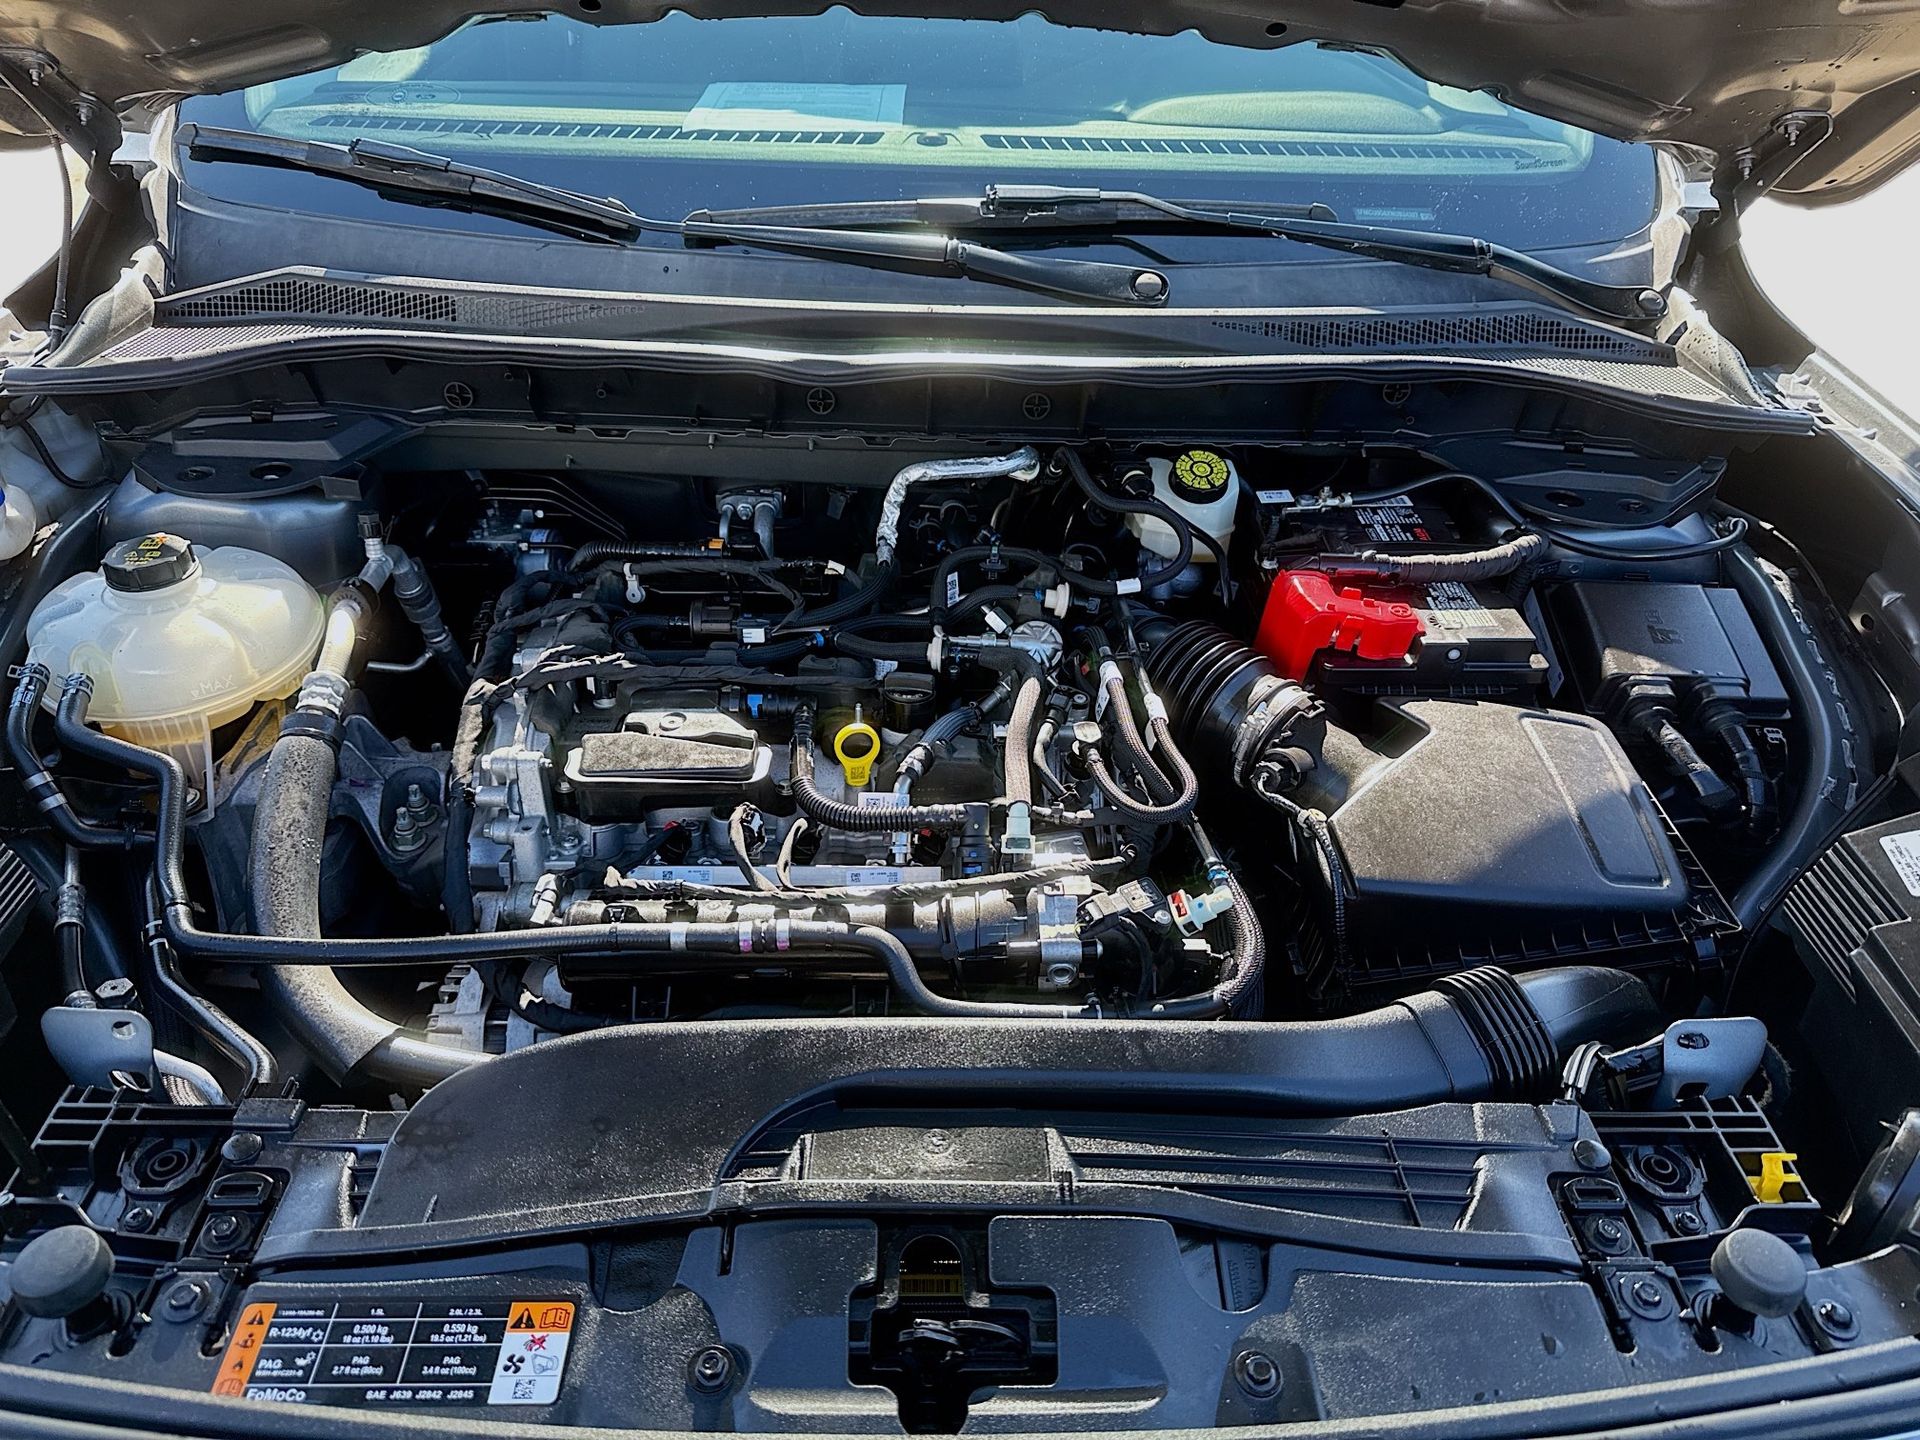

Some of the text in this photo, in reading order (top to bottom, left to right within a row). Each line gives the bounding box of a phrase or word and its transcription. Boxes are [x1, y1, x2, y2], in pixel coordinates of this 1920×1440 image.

[199, 675, 234, 694] MAX
[268, 1327, 313, 1339] R-1234yf
[353, 1324, 389, 1336] 0.500 kg
[443, 1323, 479, 1335] 0.550 kg
[430, 1334, 446, 1342] 19.5
[258, 1359, 283, 1369] PAG
[351, 1355, 370, 1365] PAG
[442, 1356, 462, 1365] PAG
[246, 1388, 306, 1401] FoMoCo
[365, 1390, 474, 1399] SAE J639 J2842 J2845
